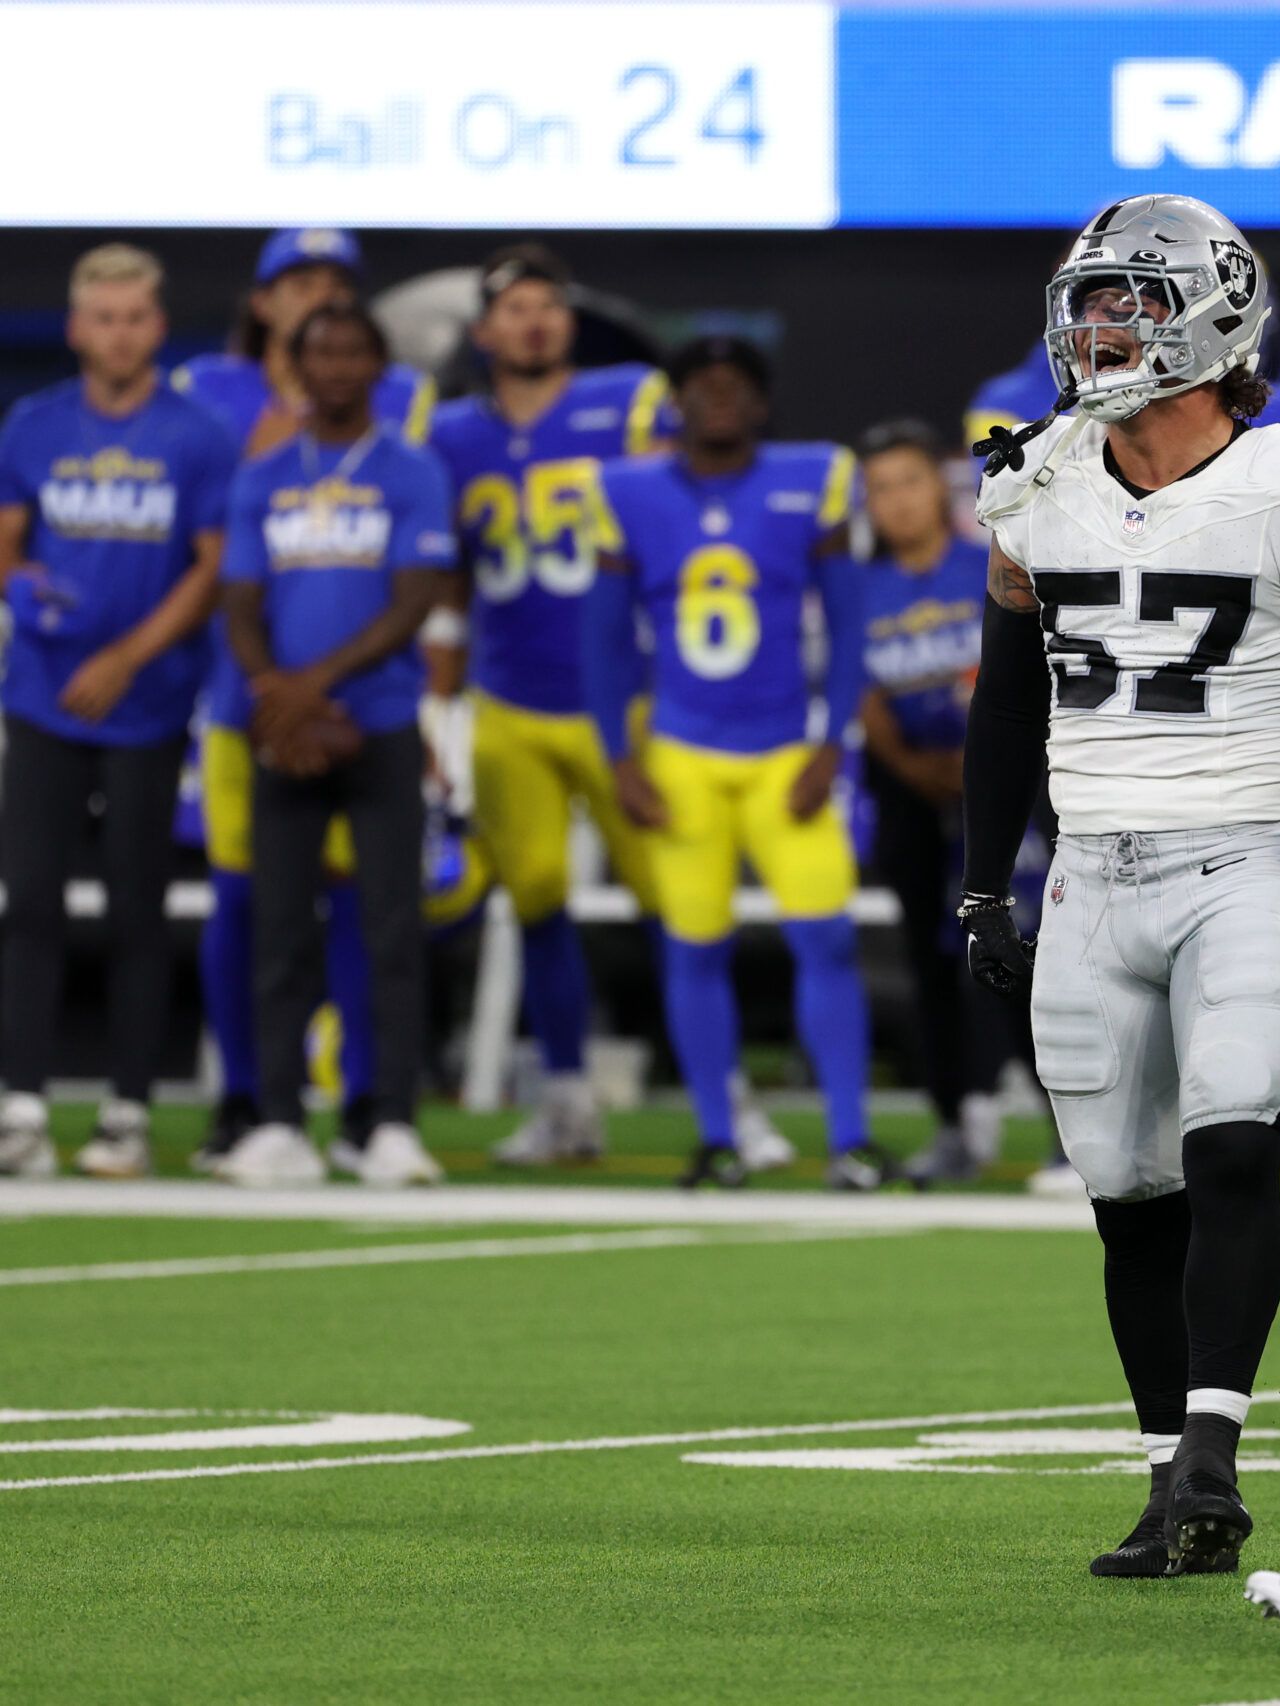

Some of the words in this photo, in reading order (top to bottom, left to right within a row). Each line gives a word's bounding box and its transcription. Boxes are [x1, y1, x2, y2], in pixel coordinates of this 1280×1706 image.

[265, 92, 423, 169] Ball
[452, 92, 579, 169] On
[615, 61, 769, 169] 24
[461, 456, 599, 600] 35
[674, 543, 762, 680] 6
[1031, 567, 1258, 718] 57
